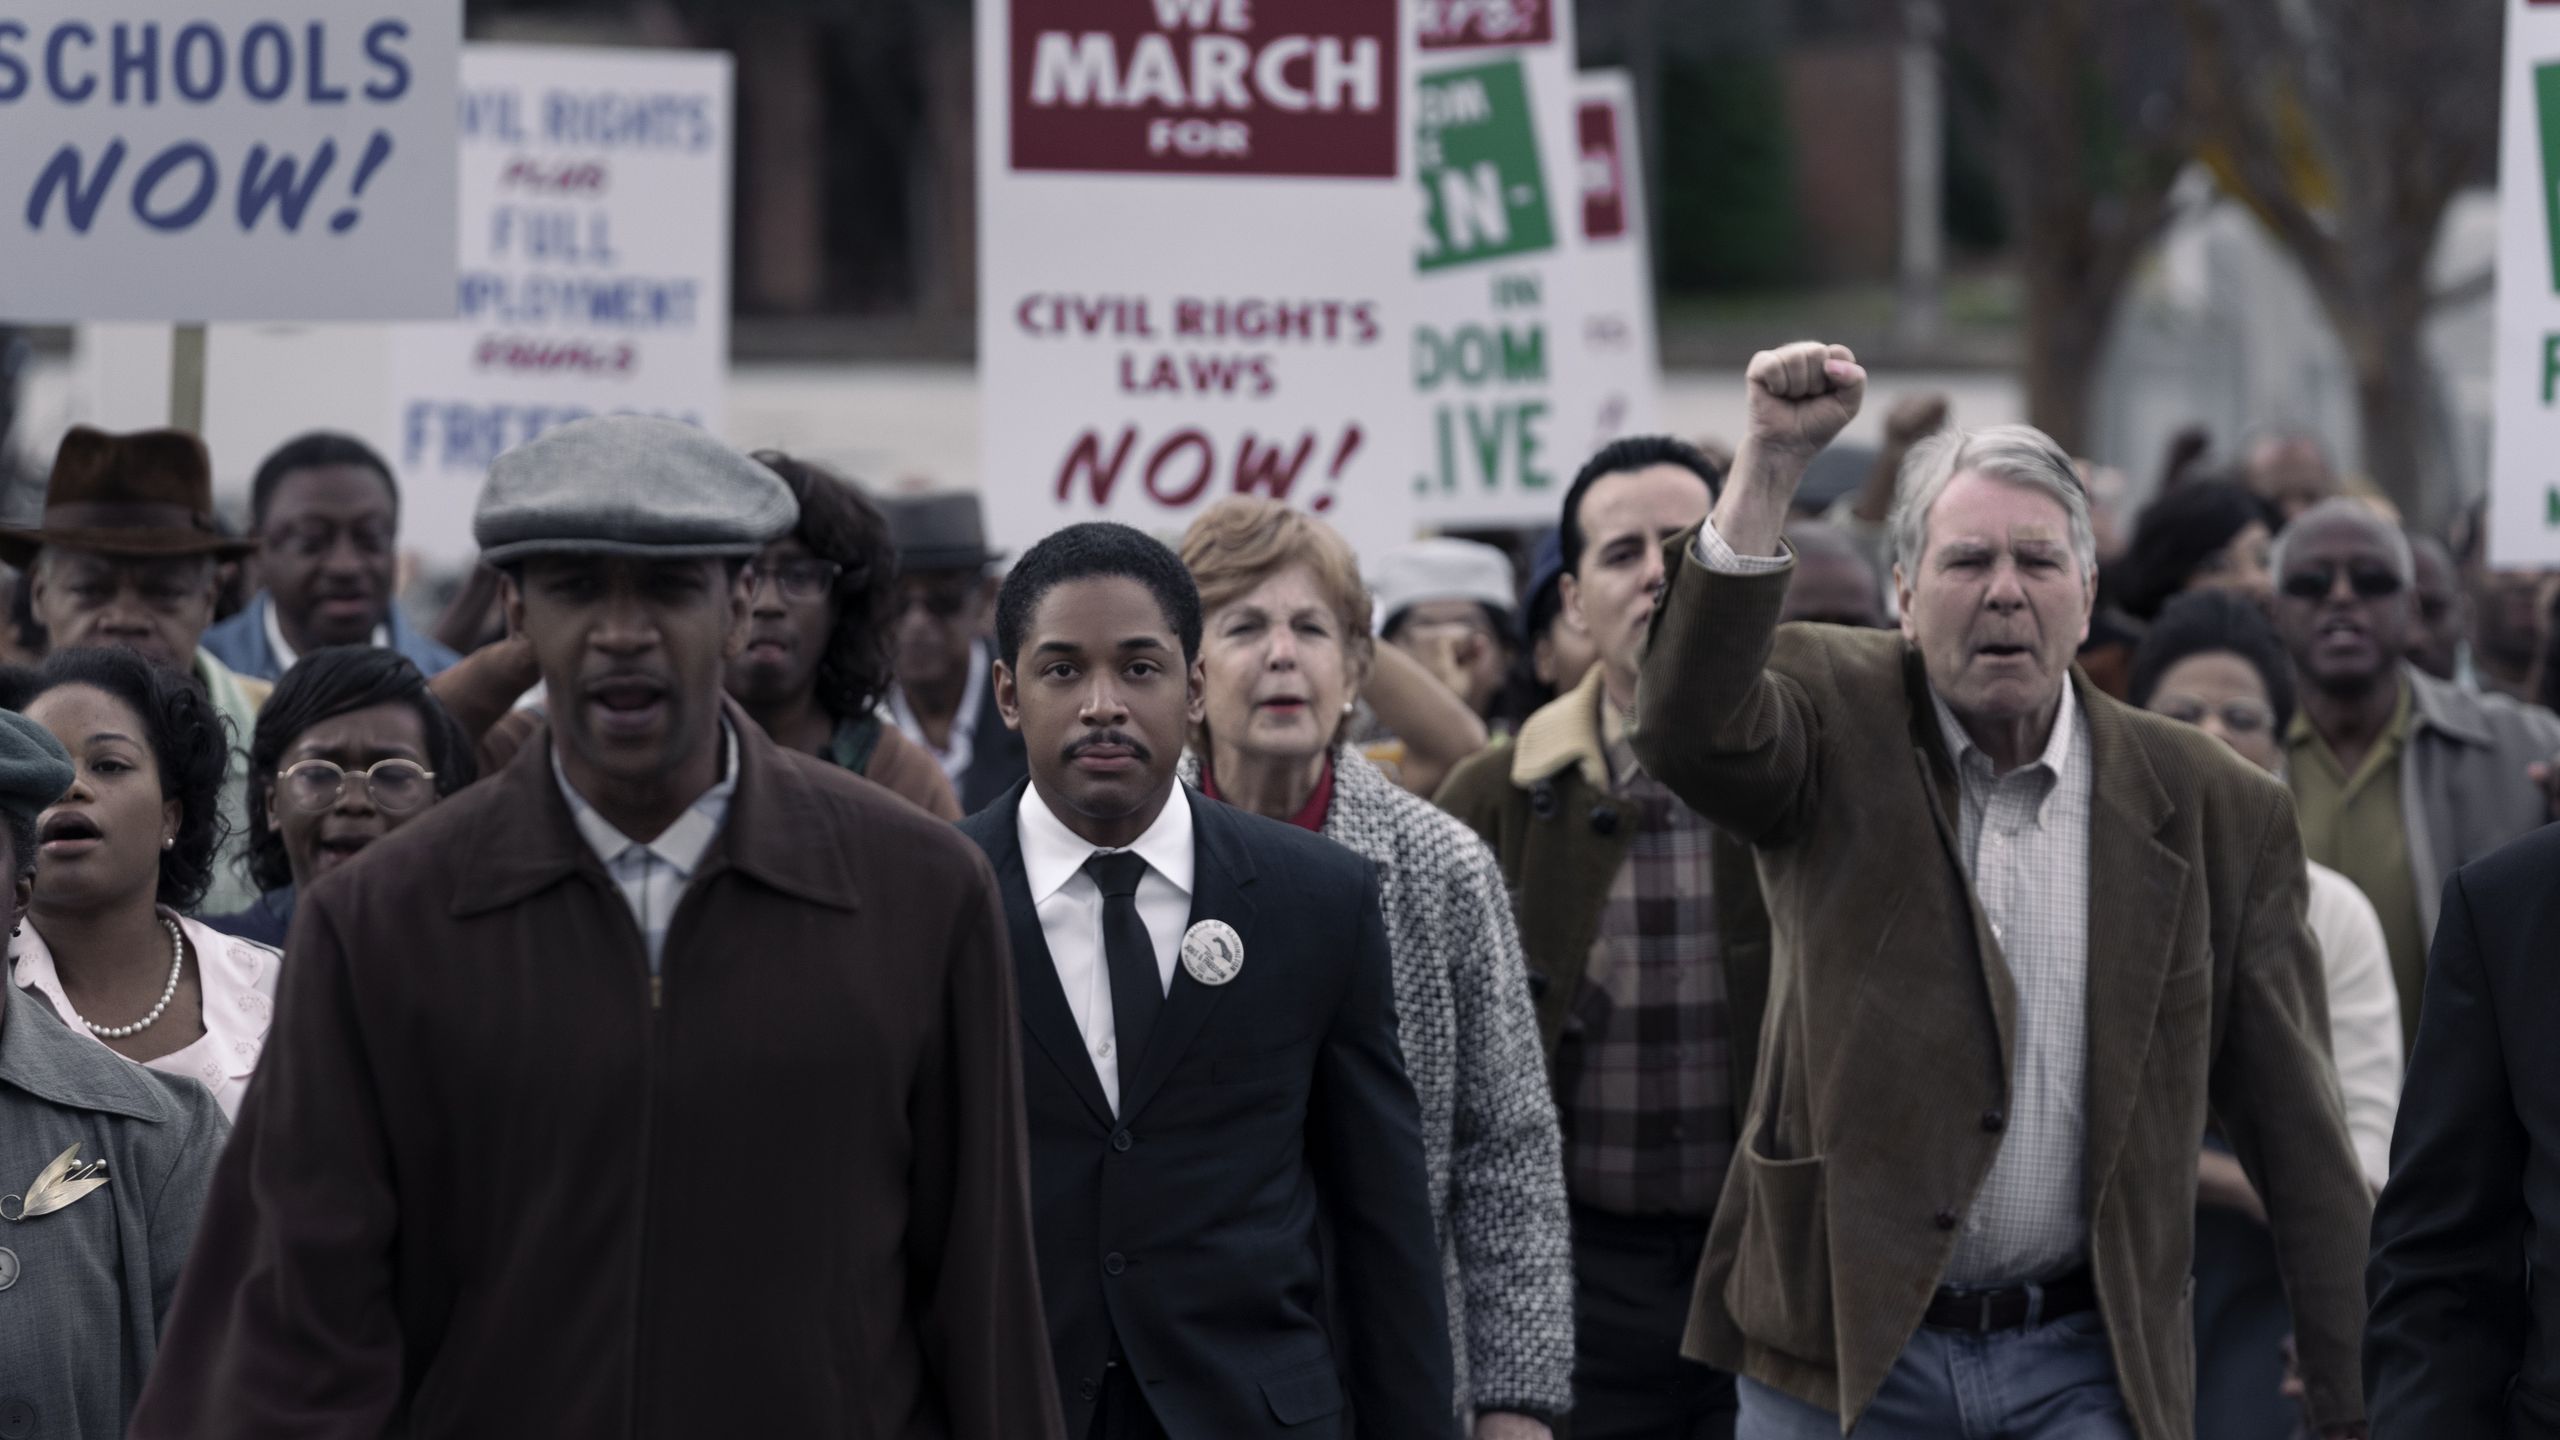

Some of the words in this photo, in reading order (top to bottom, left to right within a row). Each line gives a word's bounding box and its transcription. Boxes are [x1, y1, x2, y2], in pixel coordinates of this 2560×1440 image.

[1151, 0, 1252, 30] WE
[0, 20, 411, 105] SCHOOLS
[1030, 30, 1380, 113] MARCH
[545, 92, 714, 152] RIGHTS
[1147, 118, 1250, 155] FOR
[25, 129, 394, 235] NOW!
[491, 203, 616, 262] FULL
[457, 272, 700, 325] PLOYMENT
[1016, 294, 1150, 338] CIVIL
[1173, 297, 1380, 343] RIGHTS
[1118, 351, 1276, 393] LAWS
[1056, 424, 1364, 512] NOW!
[1413, 402, 1553, 490] IVE
